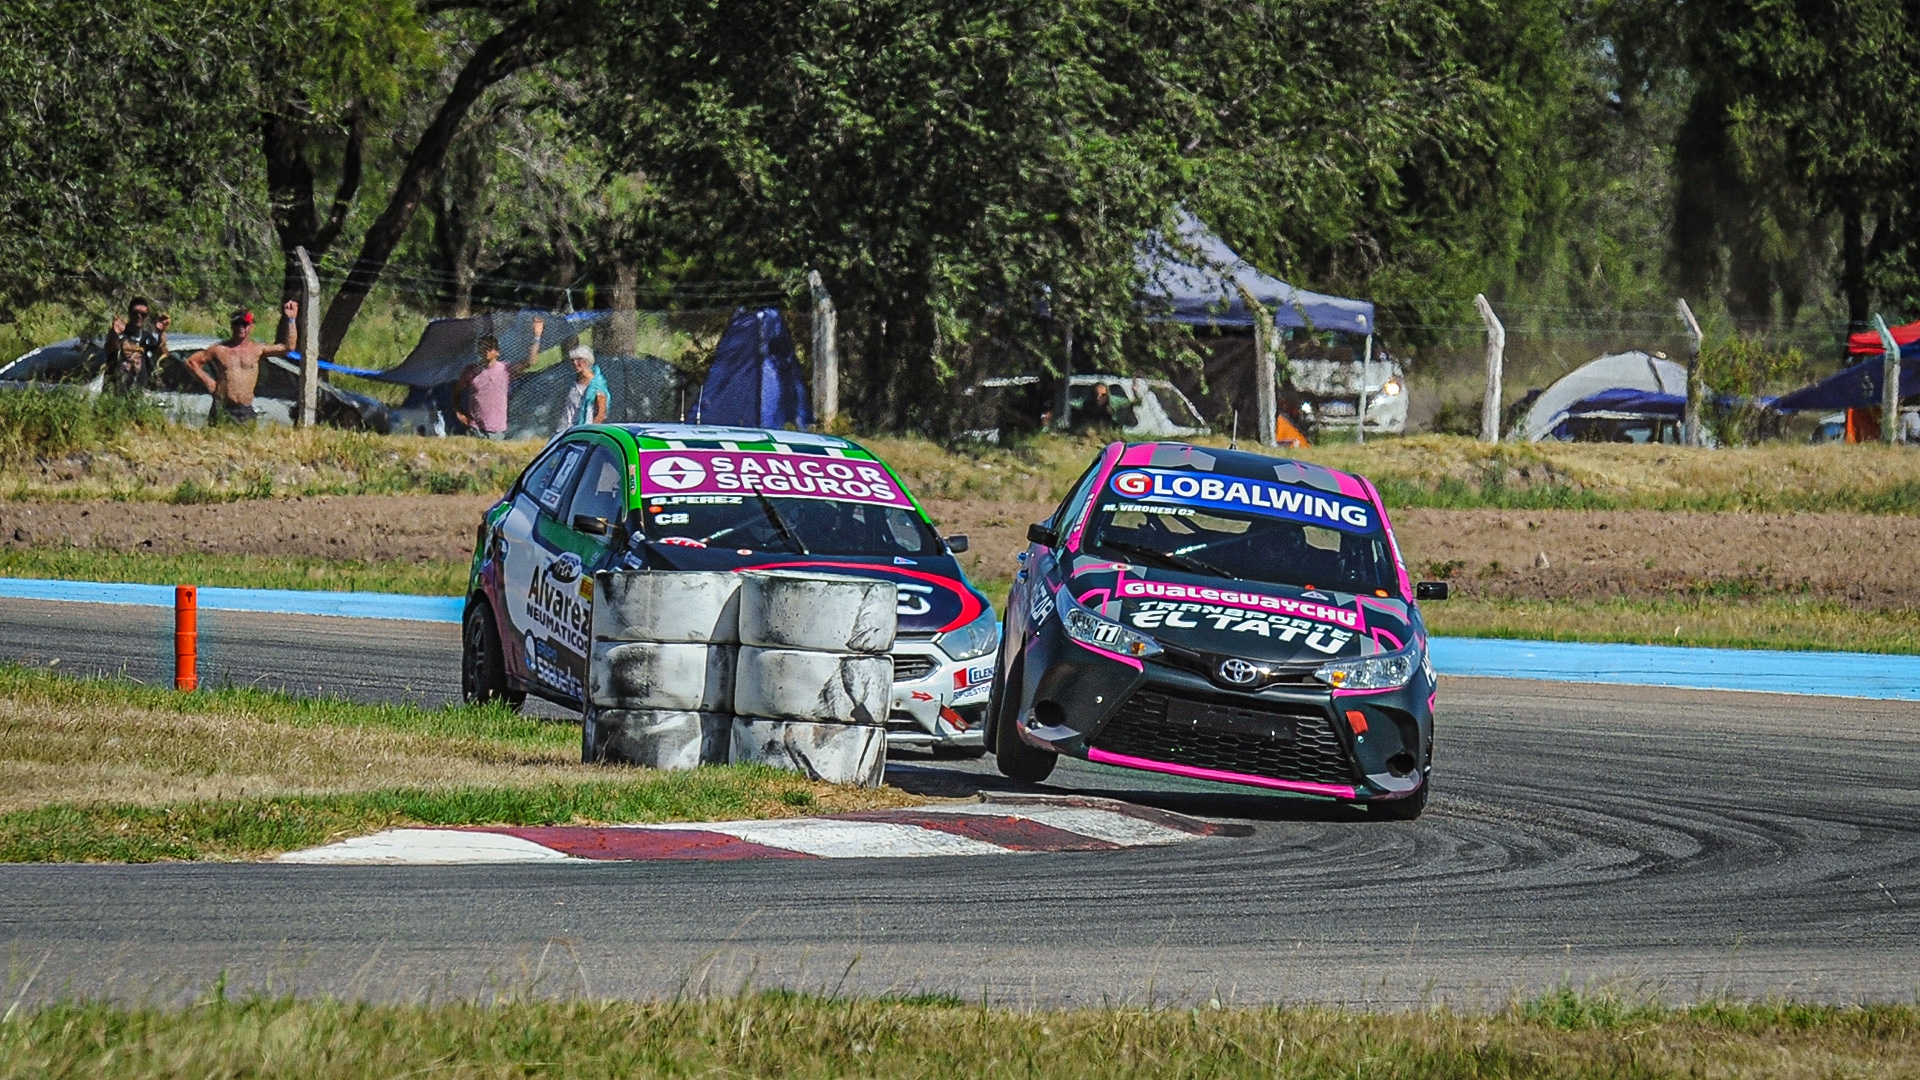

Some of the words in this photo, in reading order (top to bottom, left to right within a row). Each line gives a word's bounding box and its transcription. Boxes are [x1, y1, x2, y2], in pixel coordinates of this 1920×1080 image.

[711, 457, 888, 484] SANCOR
[715, 473, 896, 501] SEGUROS
[1118, 473, 1367, 527] GLOBALWING
[1119, 504, 1177, 515] VERONESI
[1095, 624, 1119, 643] 11
[1129, 609, 1198, 628] EL
[1205, 614, 1347, 655] TATU
[1139, 601, 1354, 642] TRANSPORTE
